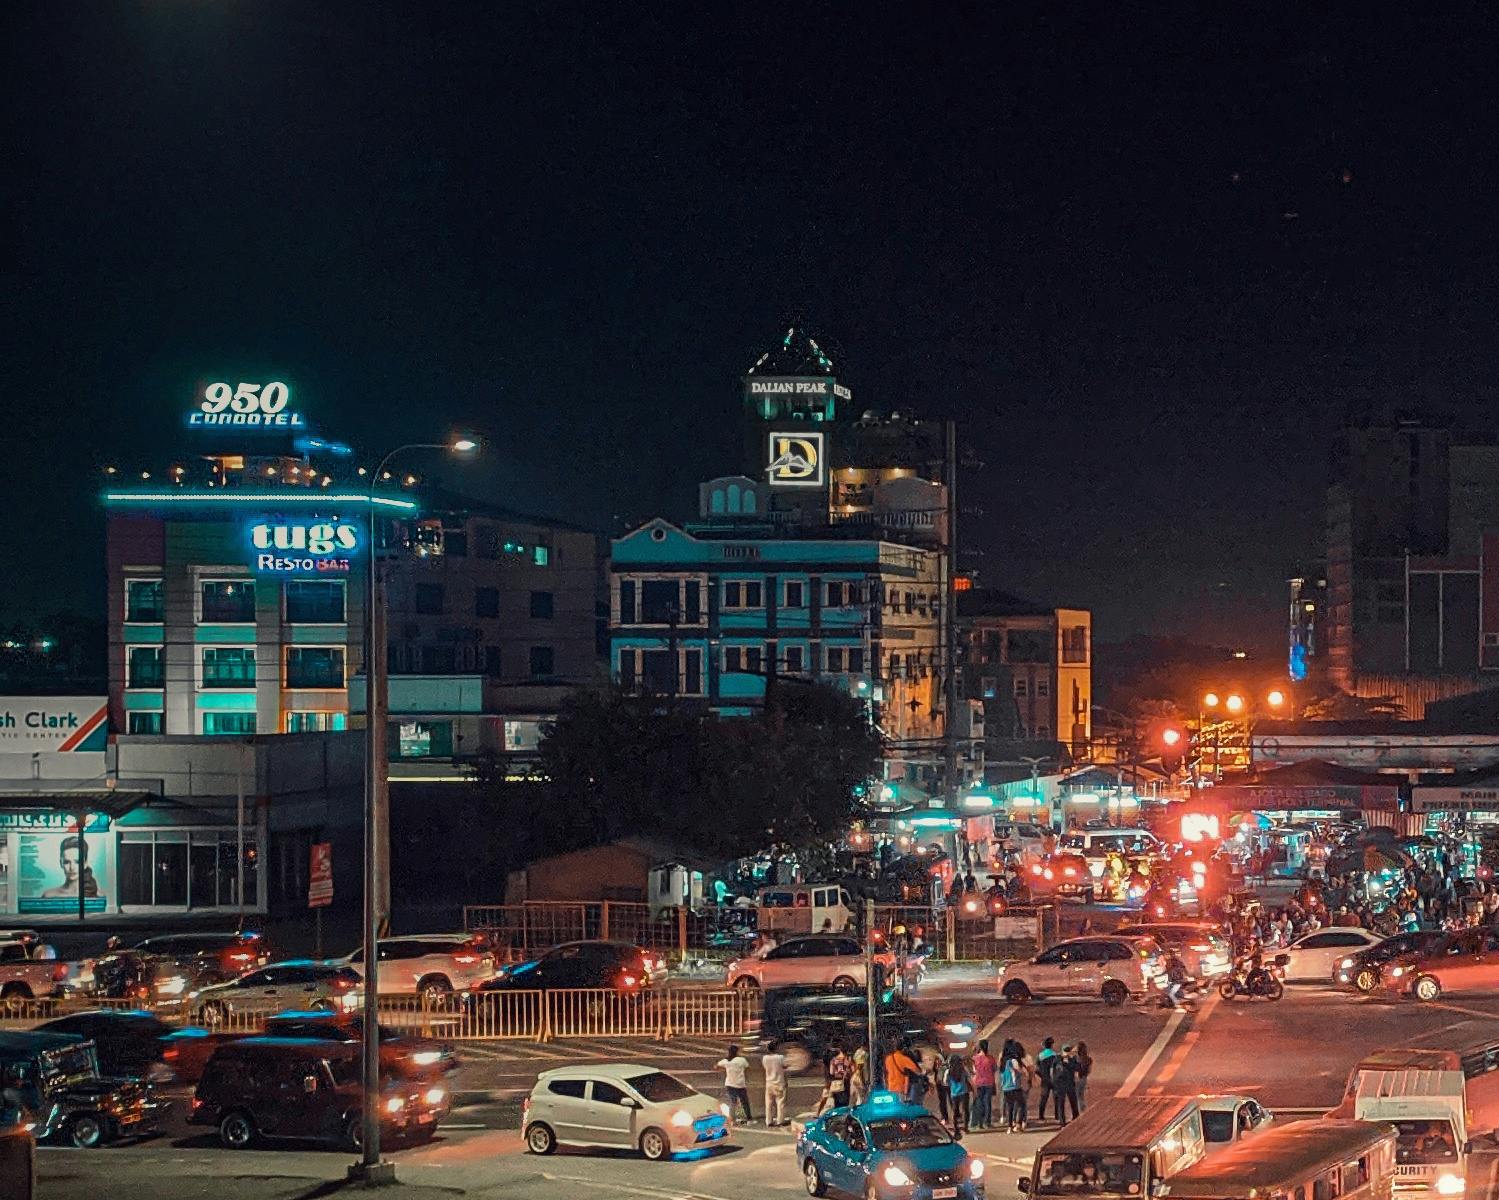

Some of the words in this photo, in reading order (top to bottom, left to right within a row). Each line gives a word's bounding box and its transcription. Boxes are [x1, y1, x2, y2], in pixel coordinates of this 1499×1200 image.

[752, 383, 793, 393] DALIAN
[796, 383, 827, 393] PEAK
[201, 382, 289, 414] 950
[190, 413, 304, 425] CONDOTEL
[252, 523, 358, 554] tugs
[25, 711, 79, 728] Clark
